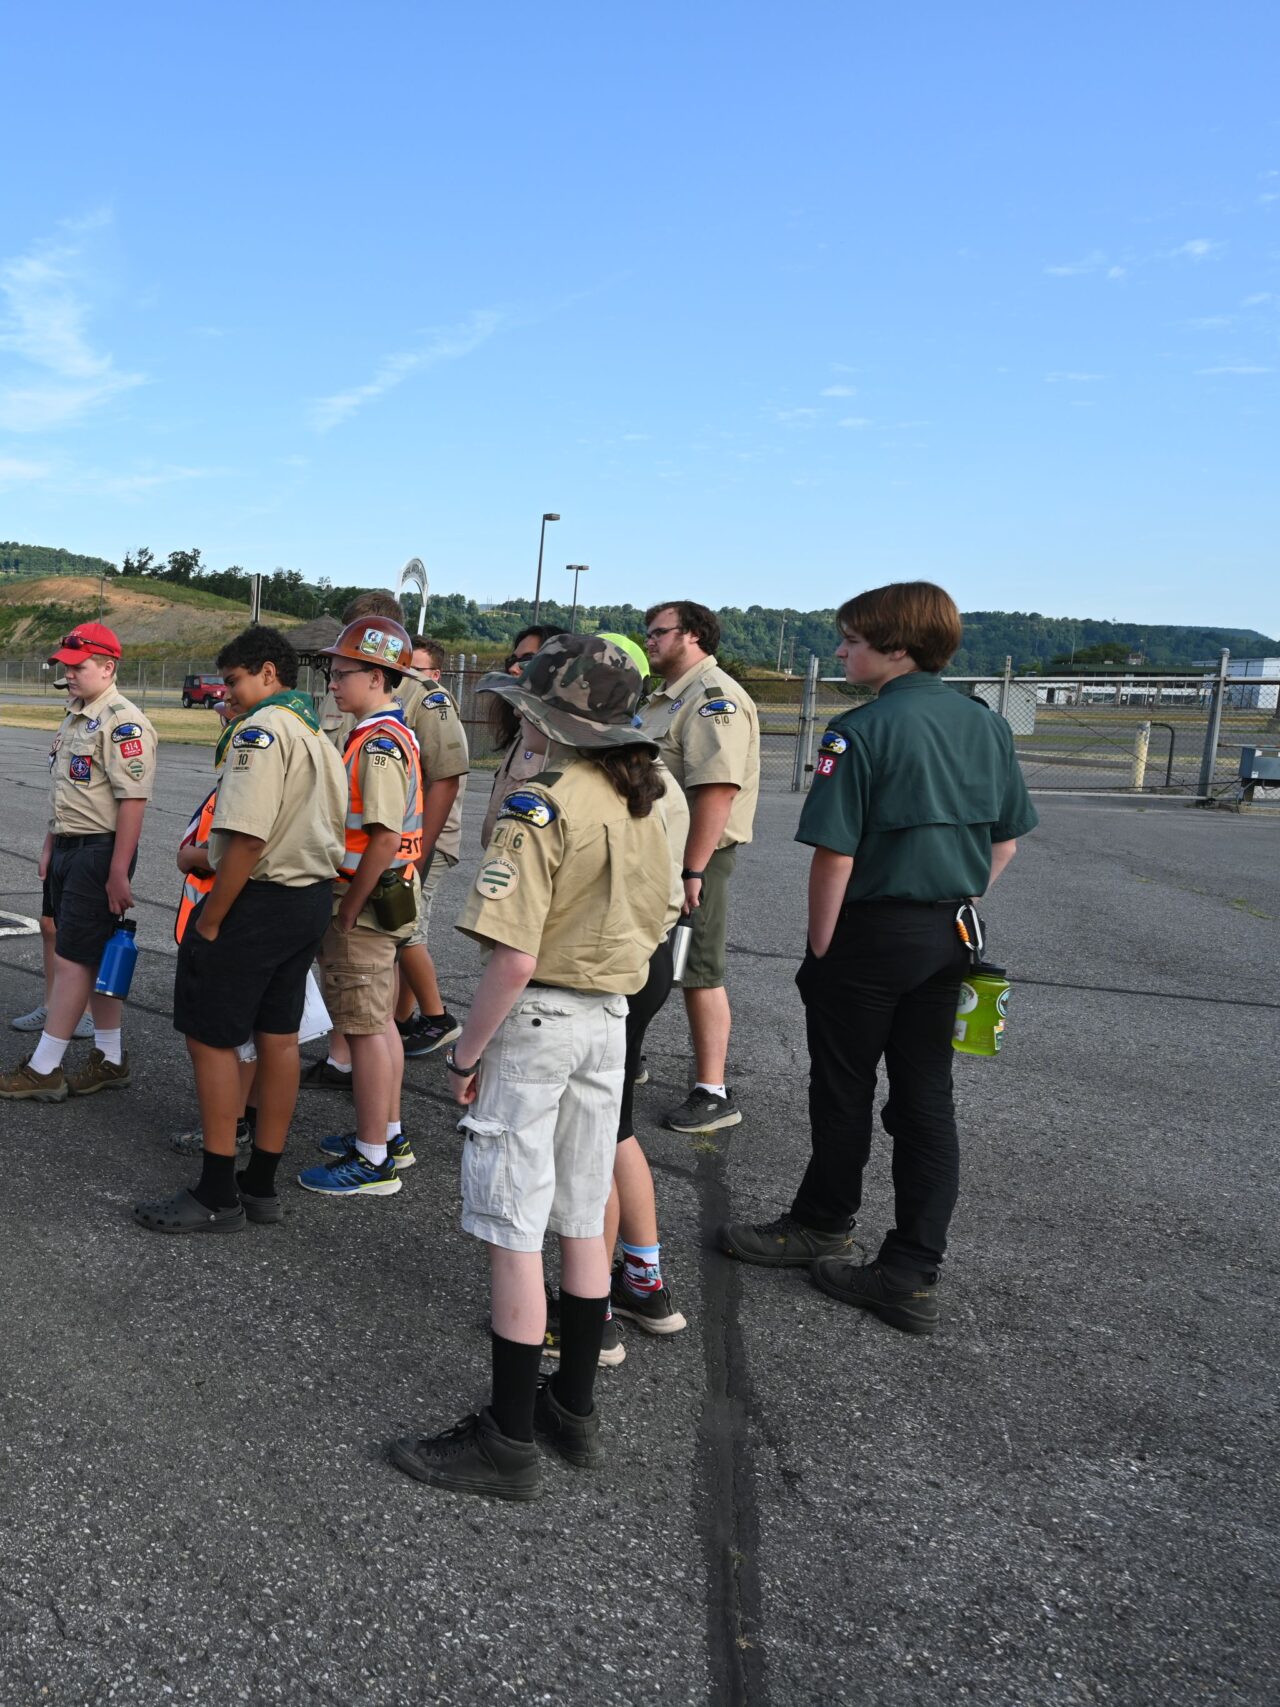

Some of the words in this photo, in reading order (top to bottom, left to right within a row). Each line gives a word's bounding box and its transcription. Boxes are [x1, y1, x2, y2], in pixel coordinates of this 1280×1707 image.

[714, 715, 730, 725] 60
[124, 741, 139, 751] 414
[238, 753, 249, 766] 10
[374, 755, 387, 766] 98
[494, 827, 524, 849] 76
